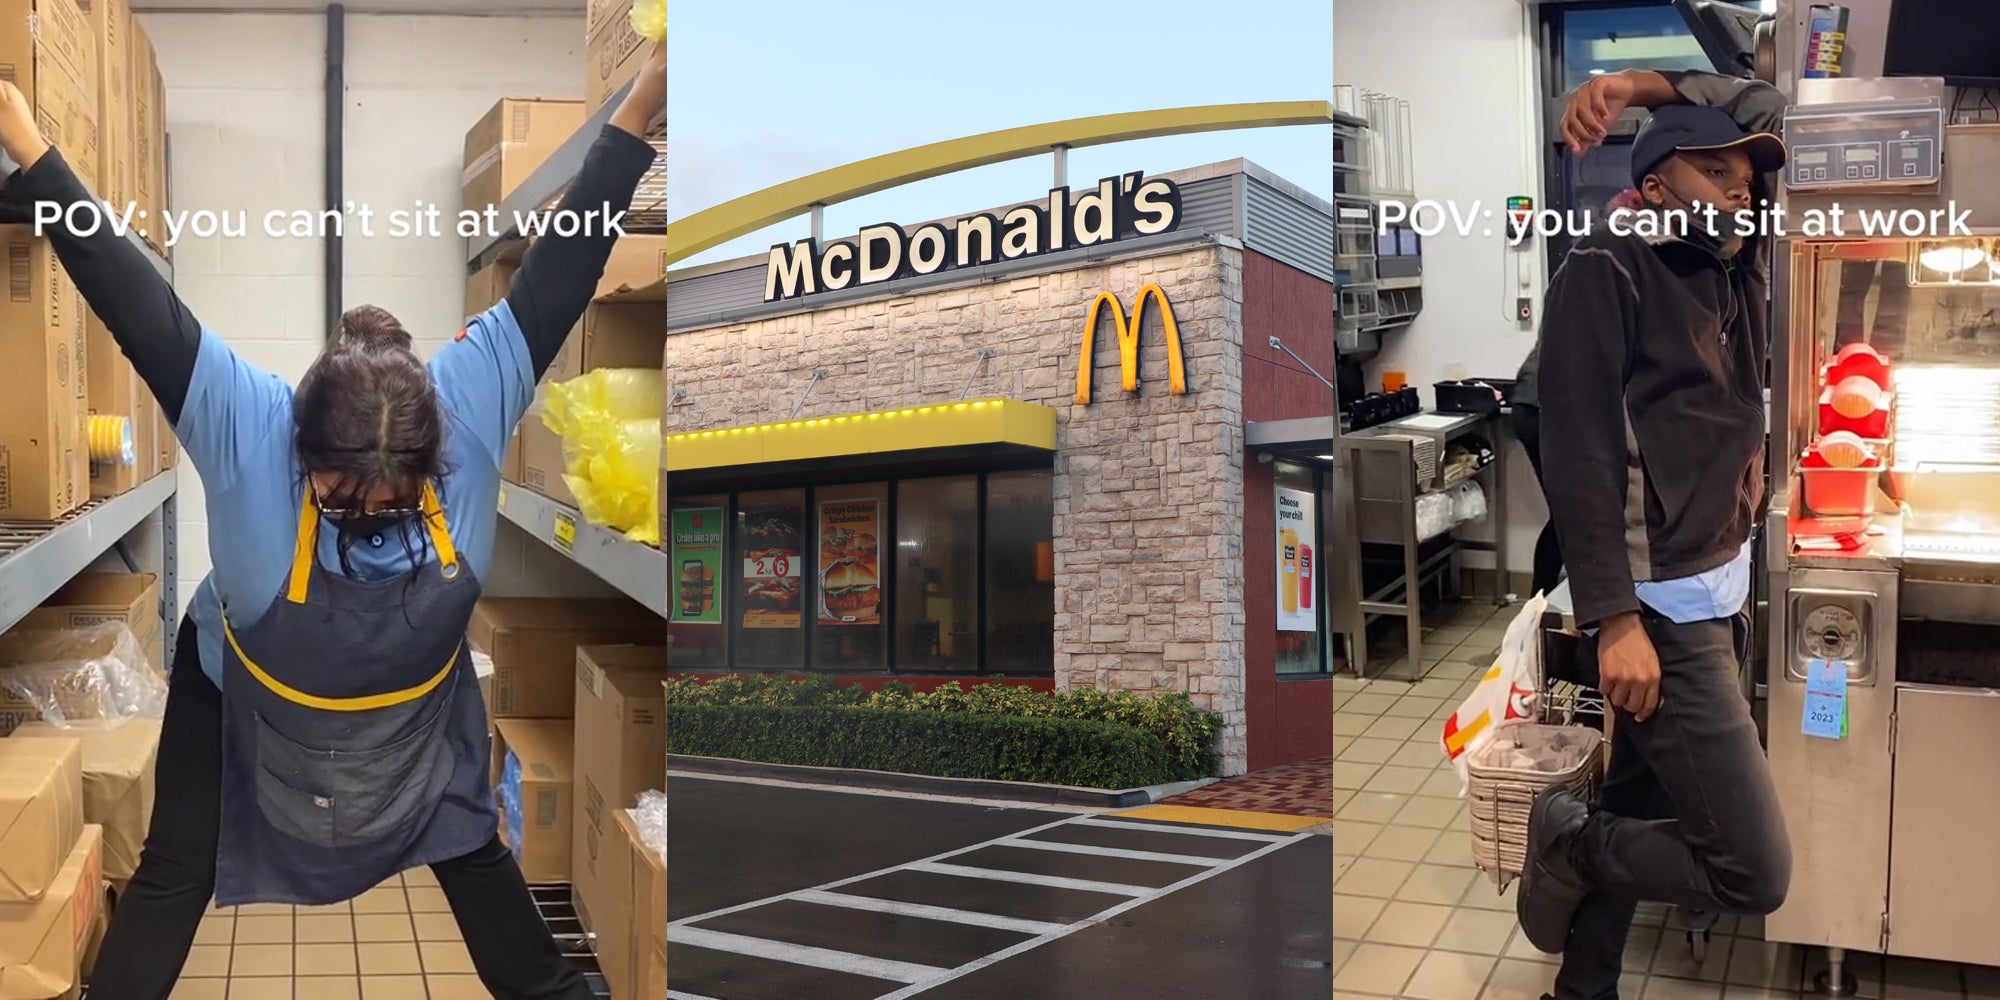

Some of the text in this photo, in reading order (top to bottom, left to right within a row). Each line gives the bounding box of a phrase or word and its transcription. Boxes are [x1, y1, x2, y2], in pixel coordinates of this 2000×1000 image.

[764, 171, 1181, 303] McDonald's
[1280, 495, 1299, 507] Choose
[824, 504, 874, 516] Crispy Chicken
[1280, 510, 1303, 520] your chill
[828, 514, 870, 523] Sandwiches
[676, 532, 693, 543] Order
[694, 531, 704, 543] like
[709, 533, 720, 544] pro
[756, 560, 765, 575] 2
[1811, 711, 1834, 723] 2023
